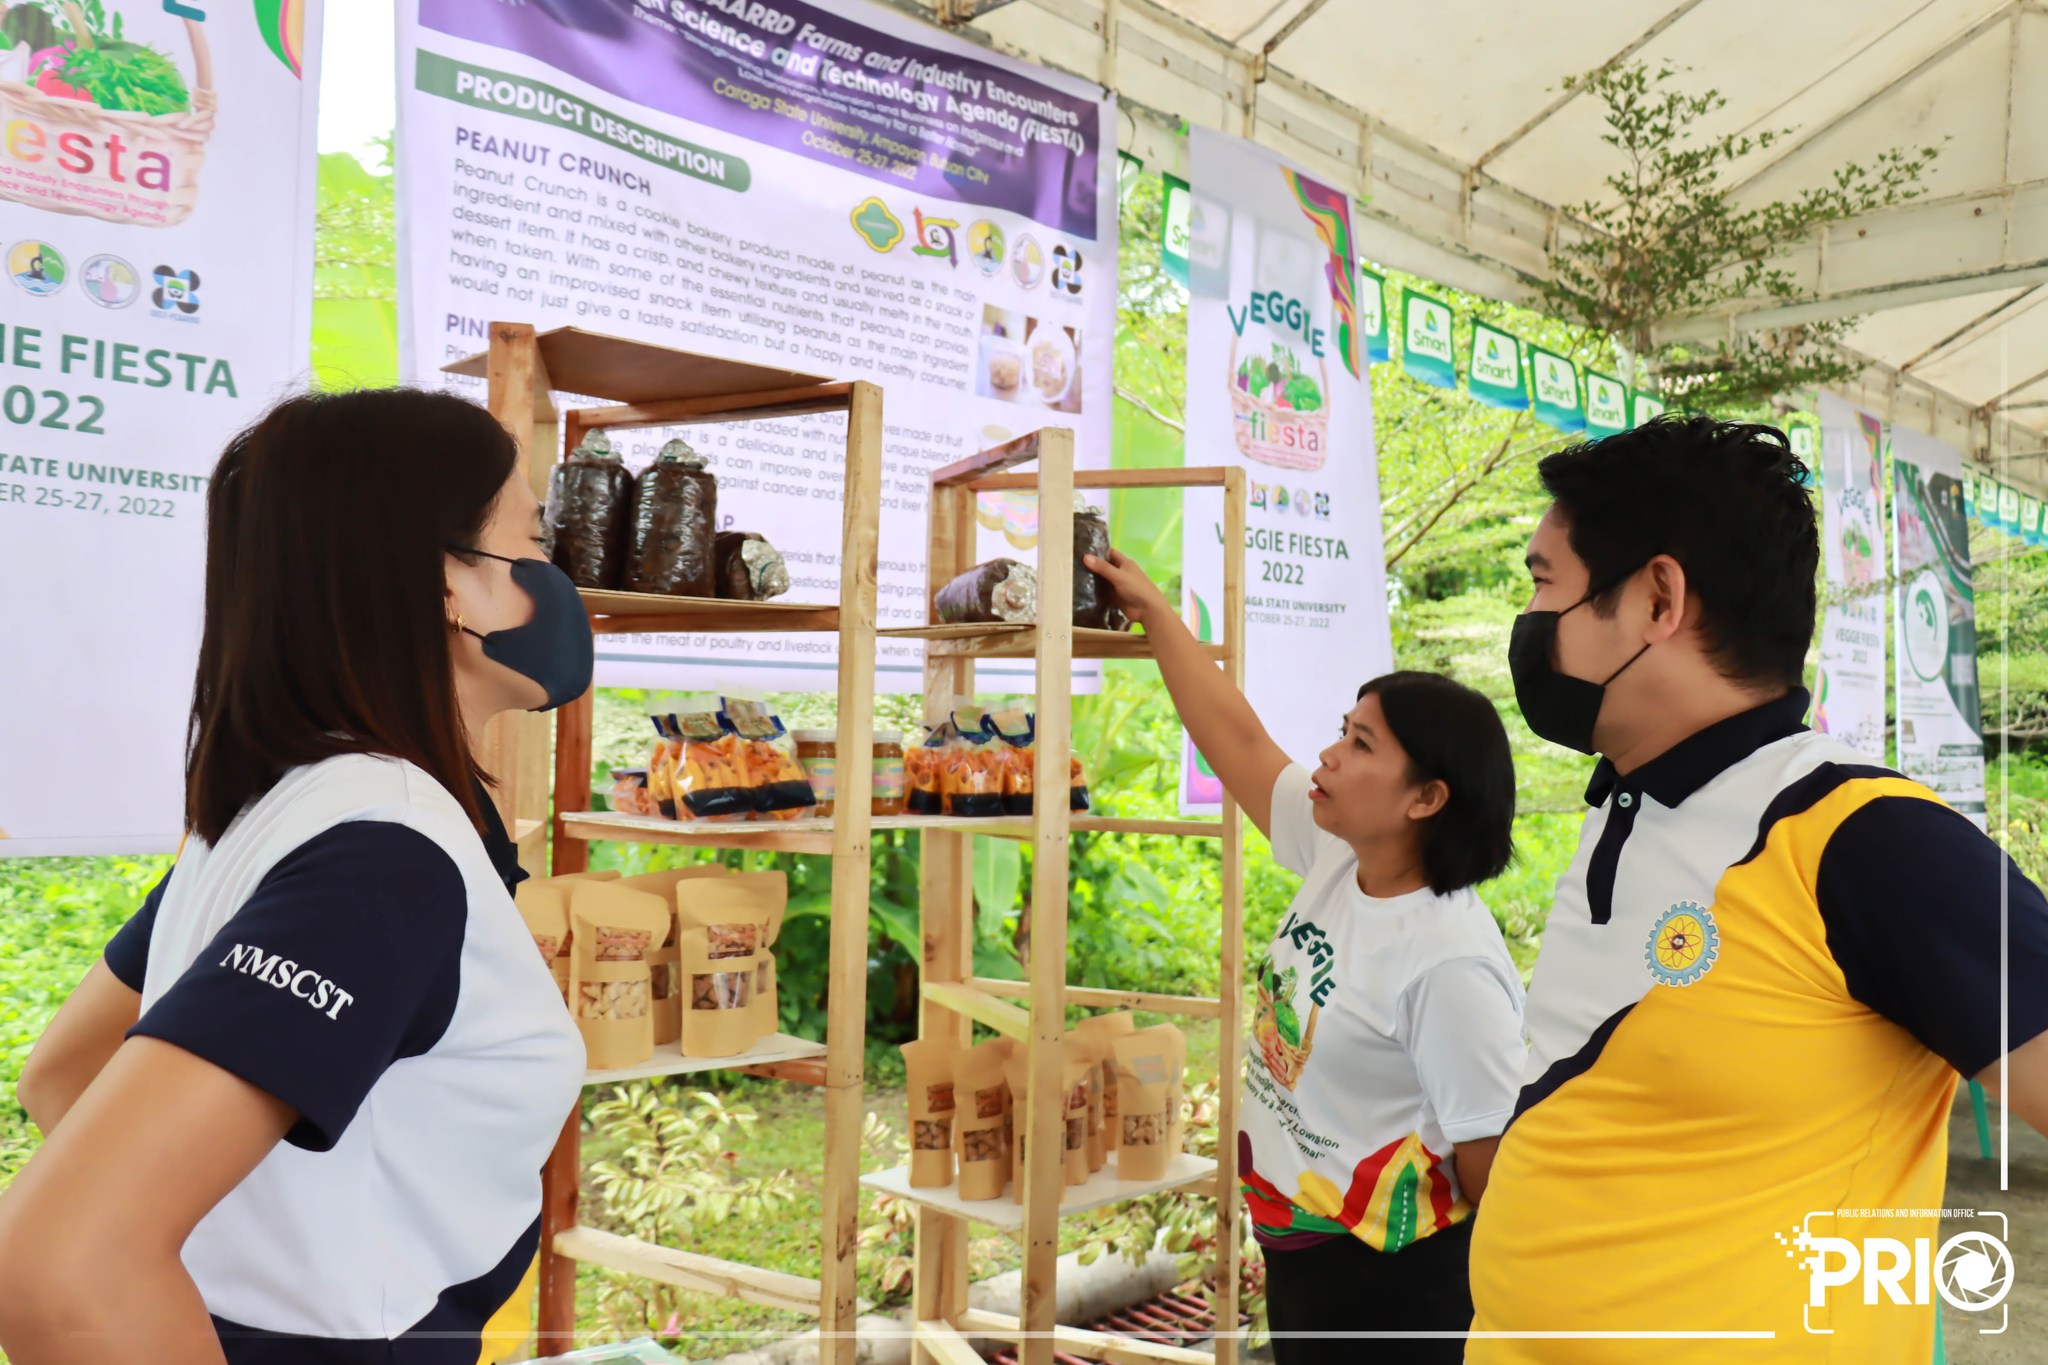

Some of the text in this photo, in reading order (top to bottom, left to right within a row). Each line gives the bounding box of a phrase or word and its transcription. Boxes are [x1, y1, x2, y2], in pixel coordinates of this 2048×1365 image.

[669, 0, 1086, 158] Science and Technology Agenda (FIESTA)
[796, 23, 1080, 127] Farms and Industry Encounters
[456, 69, 727, 182] PRODUCT DESCRIPTION
[713, 77, 772, 110] Caraga
[772, 96, 808, 122] State
[810, 110, 870, 145] University,
[966, 165, 990, 185] City
[5, 119, 171, 193] esta
[455, 126, 652, 197] PEANUT CRUNCH
[801, 130, 856, 159] October
[890, 160, 918, 180] 2022
[453, 180, 542, 216] ingredient
[546, 203, 582, 224] and
[587, 212, 637, 237] mixed
[642, 226, 671, 246] with
[673, 234, 708, 257] other
[711, 246, 756, 273] bakery
[760, 261, 831, 289] ingredients
[834, 278, 861, 295] and
[864, 284, 905, 304] served
[454, 157, 515, 187] Peanut
[524, 175, 588, 204] Crunch
[596, 192, 608, 207] is
[616, 199, 628, 212] a
[634, 203, 682, 230] cookie
[686, 219, 734, 248] bakery
[739, 238, 791, 262] product
[797, 252, 836, 273] made
[841, 263, 856, 276] of
[860, 267, 906, 287] peanut
[930, 280, 949, 296] the
[450, 227, 498, 251] when
[504, 238, 558, 264] taken.
[566, 249, 601, 272] With
[608, 261, 653, 283] some
[659, 273, 676, 287] of
[681, 275, 704, 294] the
[709, 285, 767, 310] essential
[771, 300, 826, 324] nutrients
[830, 311, 856, 329] that
[859, 318, 906, 341] peanuts
[909, 331, 932, 347] can
[452, 205, 512, 231] dessert
[517, 219, 560, 242] item.
[581, 231, 611, 252] has
[616, 242, 628, 256] a
[676, 256, 704, 274] and
[708, 264, 751, 289] chewy
[754, 277, 798, 299] texture
[801, 287, 829, 306] and
[832, 296, 876, 317] usually
[879, 304, 911, 323] melts
[924, 313, 942, 330] the
[448, 272, 500, 297] would
[507, 284, 535, 303] not
[540, 291, 570, 310] just
[576, 298, 612, 317] give
[618, 306, 630, 321] a
[637, 308, 675, 329] taste
[680, 318, 760, 347] satisfaction
[764, 334, 787, 352] but
[790, 341, 800, 355] a
[804, 343, 845, 366] happy
[849, 354, 875, 370] and
[877, 359, 917, 381] healthy
[449, 247, 970, 374] having an improvised snack item utilizing peanuts as the main ingredient
[1226, 290, 1325, 359] VEGGIE
[59, 333, 239, 399] FIESTA
[1413, 329, 1449, 356] Smart
[1476, 356, 1513, 381] Smart
[1540, 379, 1572, 403] Smart
[2, 383, 106, 436] 022
[753, 420, 798, 438] added
[1250, 410, 1319, 452] fiesta
[1590, 401, 1622, 423] Smart
[0, 452, 60, 478] TATE
[725, 455, 812, 479] can improve
[736, 434, 795, 457] delicious
[801, 446, 827, 462] and
[34, 486, 109, 515] 25-27,
[117, 495, 176, 519] 2022
[762, 480, 836, 502] cancer and
[1214, 521, 1350, 560] VGGIE FIESTA
[1261, 559, 1305, 586] 2022
[1265, 597, 1347, 614] STATE UNIVERSITY
[655, 633, 692, 649] meat
[709, 635, 753, 653] poultry
[756, 637, 782, 653] and
[784, 639, 832, 655] livestock
[219, 943, 354, 1020] NMSCST
